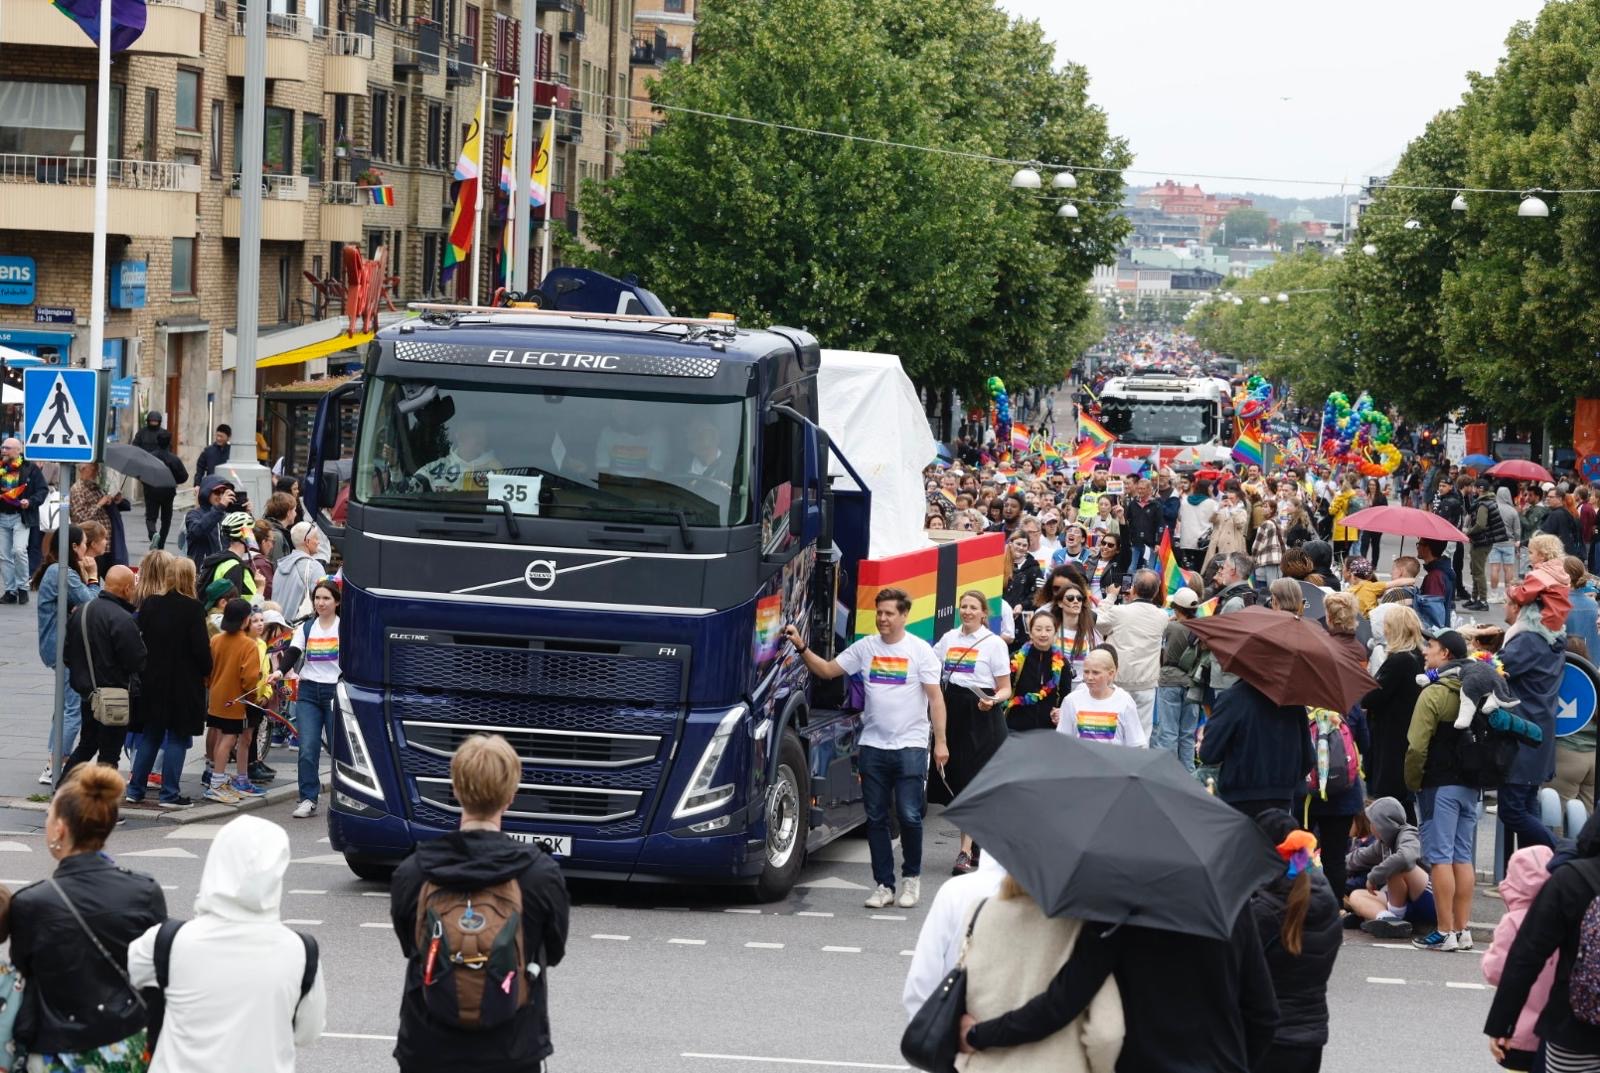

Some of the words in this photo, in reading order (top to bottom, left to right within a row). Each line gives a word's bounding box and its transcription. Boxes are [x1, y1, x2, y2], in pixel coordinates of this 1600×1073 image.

[487, 349, 621, 369] ELECTRIC
[429, 462, 461, 483] 49
[502, 484, 528, 502] 35
[389, 632, 430, 641] ELECTRIC
[658, 647, 677, 656] FH
